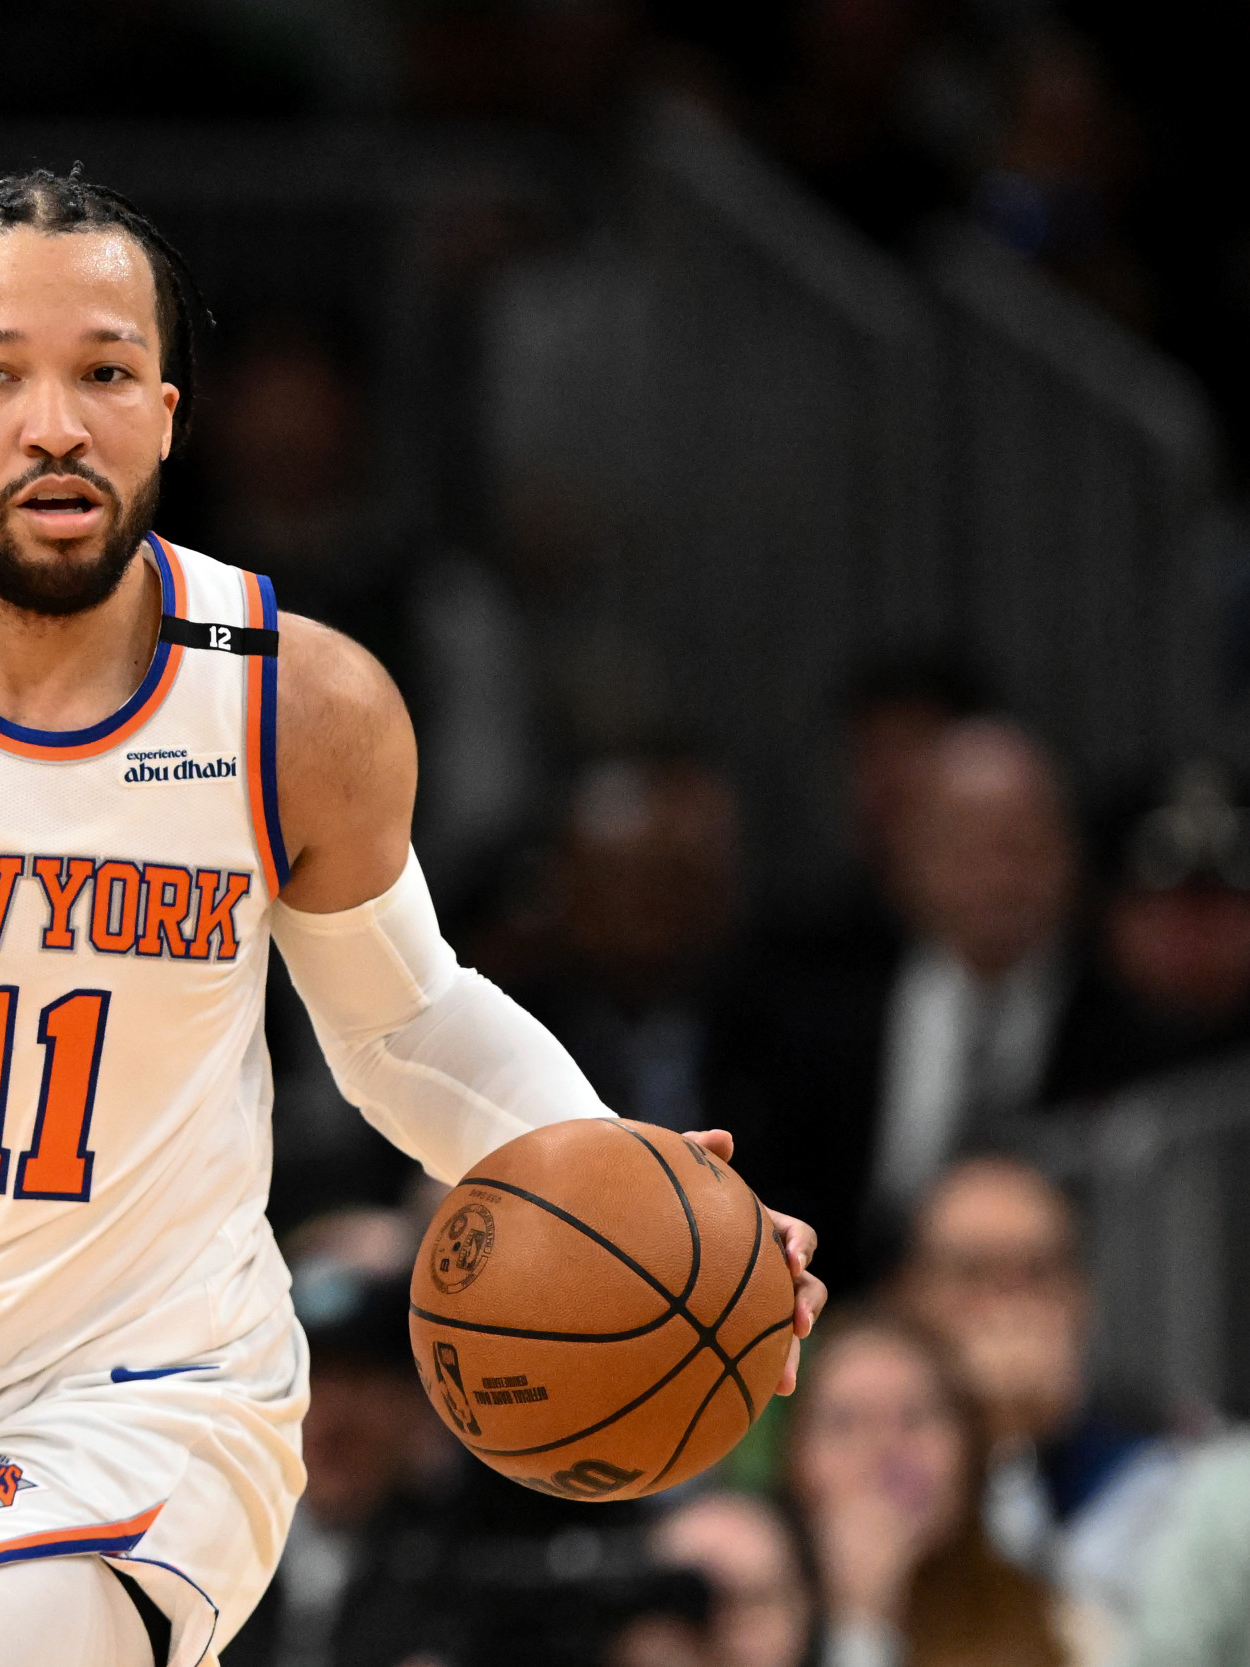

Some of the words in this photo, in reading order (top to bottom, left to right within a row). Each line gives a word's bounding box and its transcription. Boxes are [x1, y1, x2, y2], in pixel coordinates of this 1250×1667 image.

[208, 625, 232, 651] 12
[126, 749, 187, 762] experience
[124, 762, 169, 783] abu
[31, 854, 252, 961] YORK
